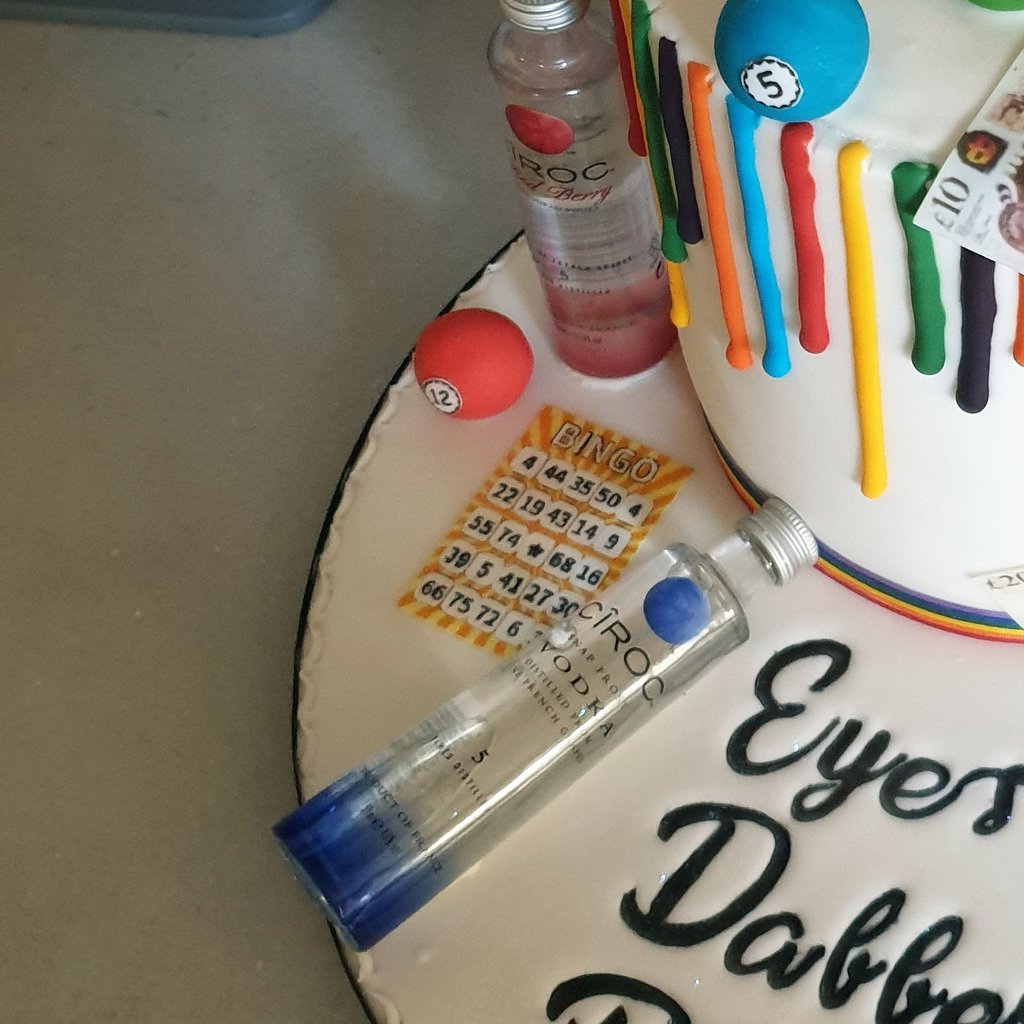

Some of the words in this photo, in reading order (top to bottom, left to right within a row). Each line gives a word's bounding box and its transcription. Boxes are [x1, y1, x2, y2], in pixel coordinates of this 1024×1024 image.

[757, 71, 784, 98] 5
[547, 185, 613, 204] Berry
[934, 177, 970, 231] £10
[429, 388, 453, 406] 12
[552, 422, 659, 483] BINGO
[522, 456, 538, 470] 4
[544, 464, 568, 484] 44
[569, 476, 596, 496] 35
[594, 488, 622, 508] 50
[628, 503, 643, 518] 4
[492, 483, 519, 504] 22
[520, 495, 545, 516] 19
[548, 508, 572, 528] 43
[571, 519, 600, 540] 14
[604, 533, 619, 550] 9
[444, 546, 472, 568] 39
[476, 560, 494, 578] 5
[499, 572, 524, 595] 41
[523, 583, 554, 606] 27
[468, 515, 495, 535] 55
[497, 527, 522, 548] 74
[549, 552, 577, 573] 68
[576, 564, 604, 586] 16
[421, 580, 448, 601] 66
[448, 592, 474, 614] 75
[475, 604, 501, 627] 72
[506, 621, 524, 637] 6
[540, 641, 614, 737] VODKA
[471, 749, 489, 764] 5
